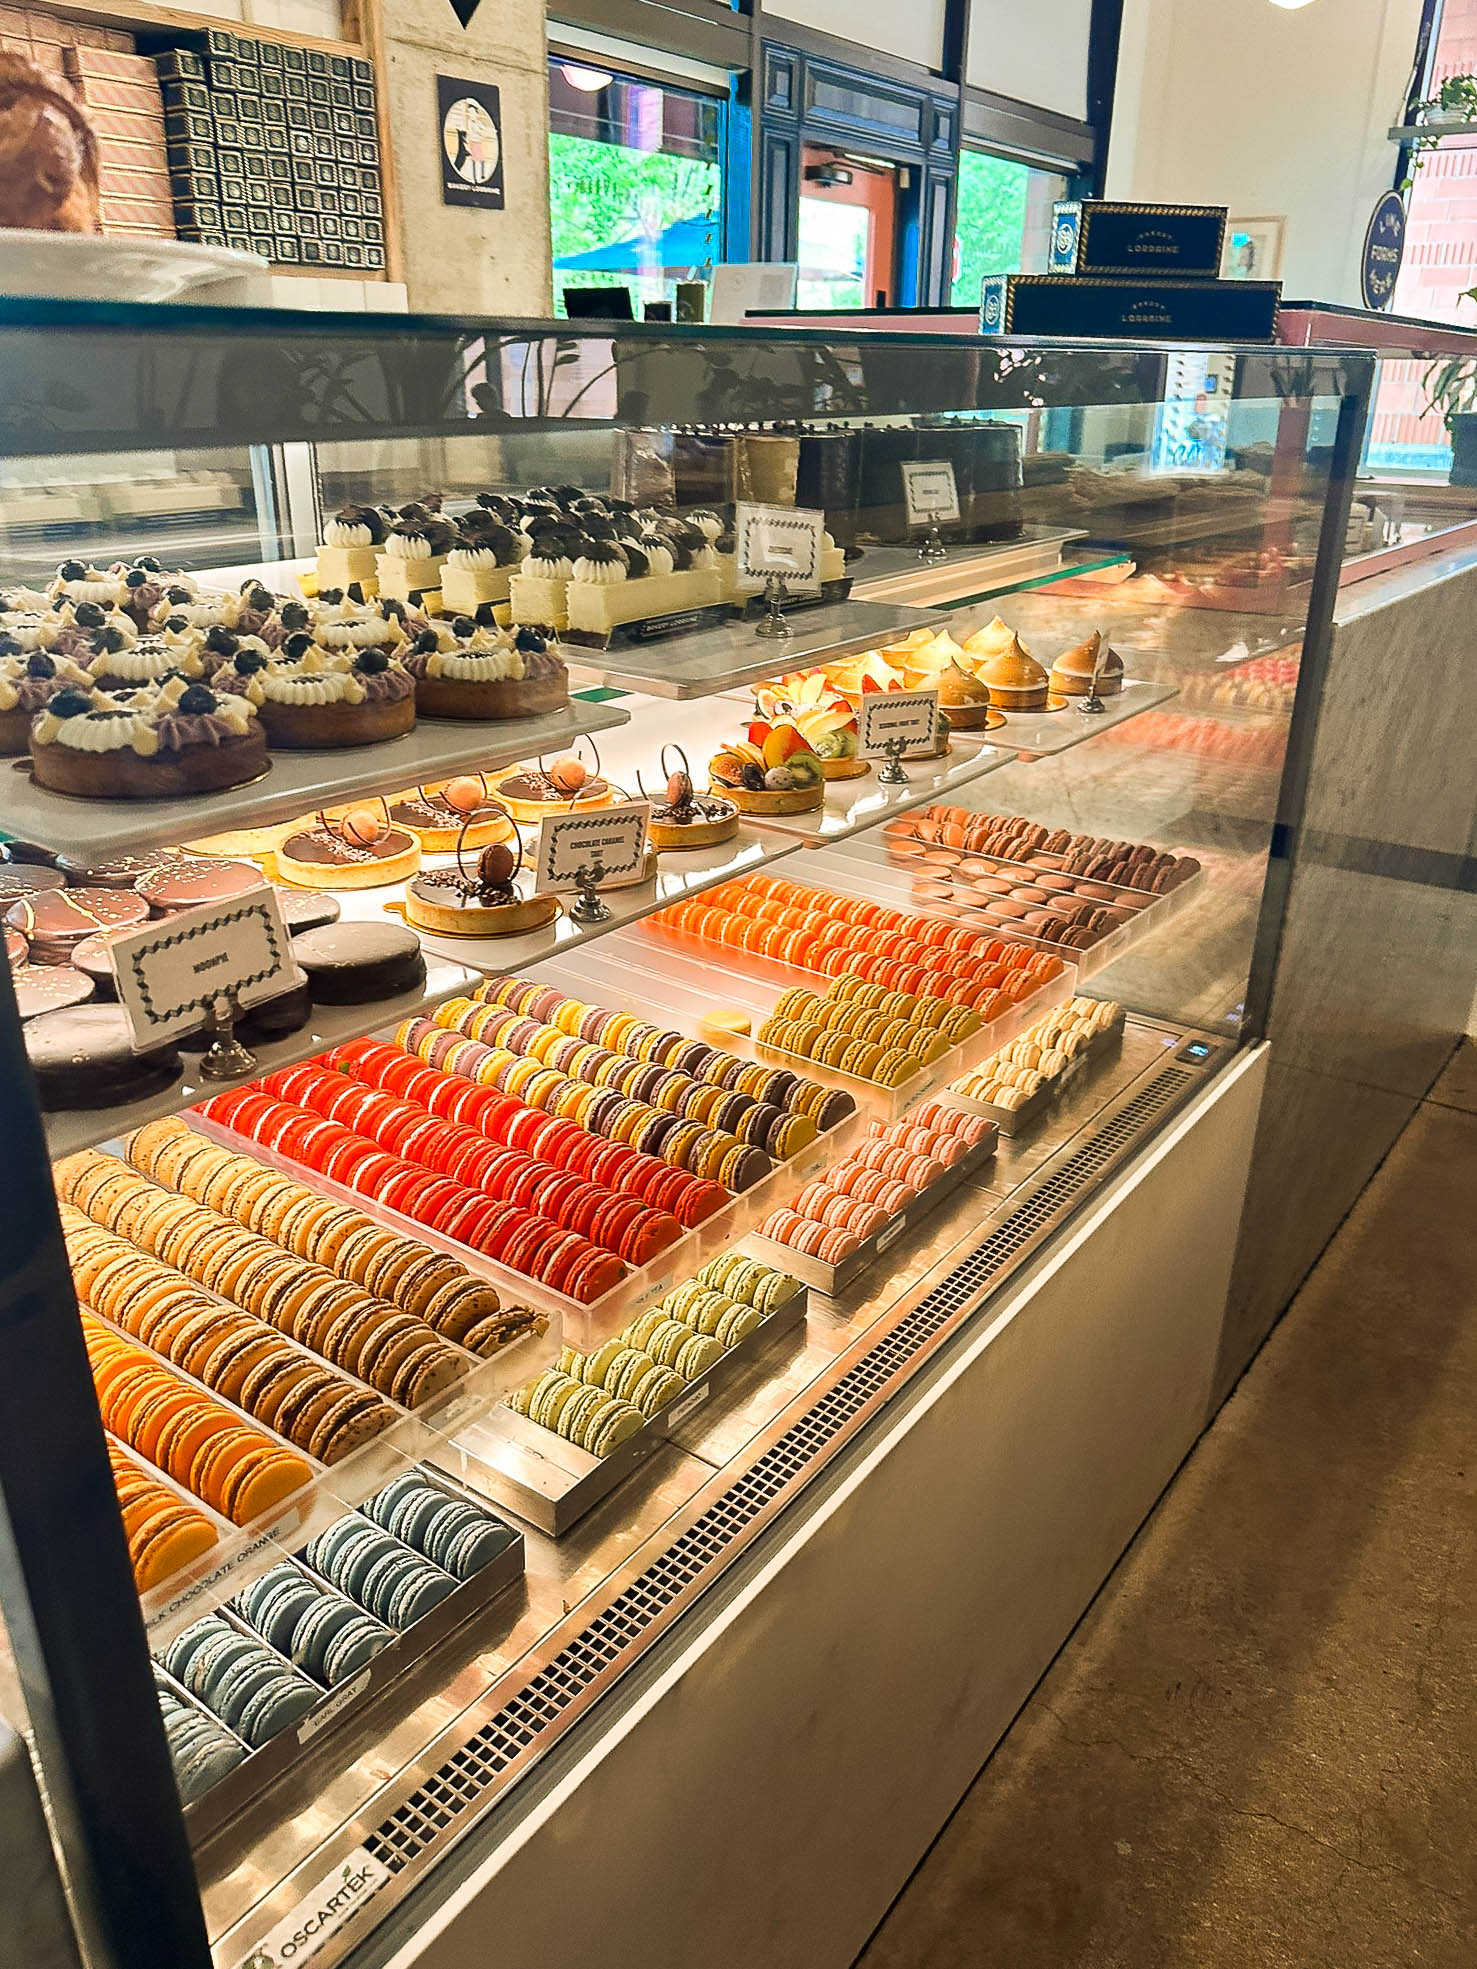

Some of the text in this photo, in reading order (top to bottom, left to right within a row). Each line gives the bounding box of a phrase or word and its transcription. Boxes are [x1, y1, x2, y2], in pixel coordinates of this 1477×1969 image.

[1371, 244, 1400, 263] FORMS
[570, 839, 600, 850] CHOCOLATE
[168, 1562, 235, 1613] CHOCOLATE
[237, 1526, 282, 1563] ORANGE
[280, 1864, 375, 1958] OSCARTEK
